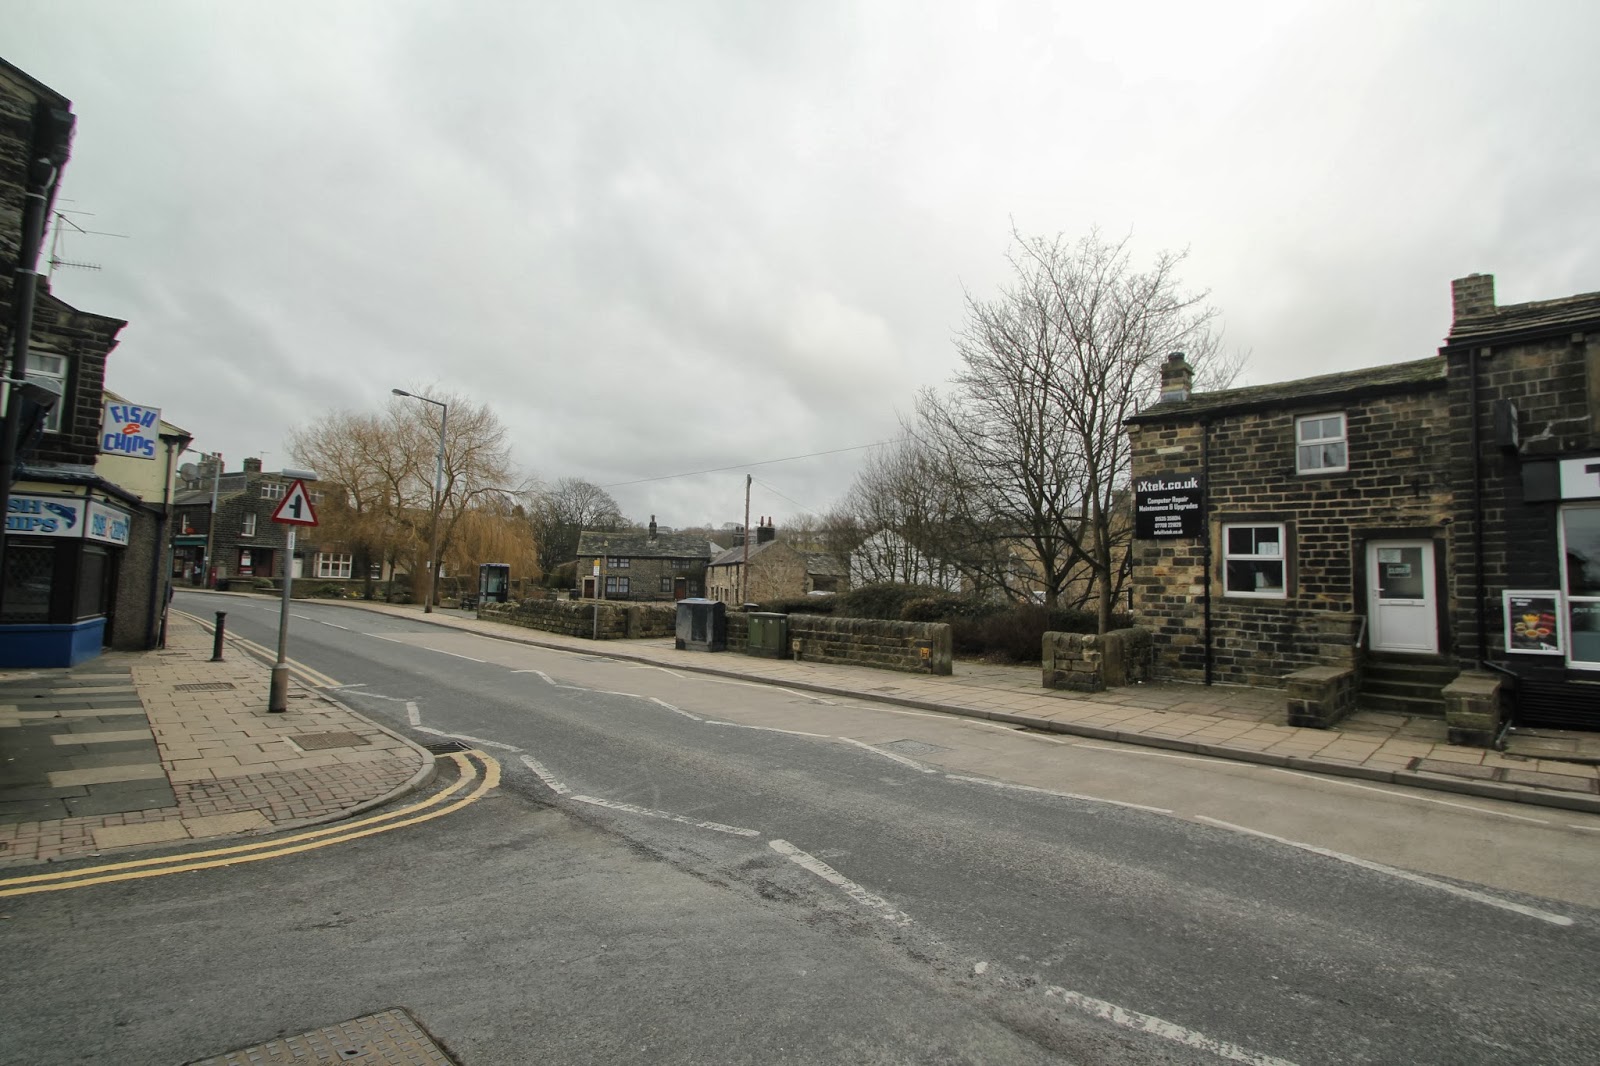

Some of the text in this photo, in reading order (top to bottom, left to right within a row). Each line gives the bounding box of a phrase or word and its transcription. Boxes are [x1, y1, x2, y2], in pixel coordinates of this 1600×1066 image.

[110, 405, 157, 428] FISH
[122, 423, 140, 434] &
[103, 433, 155, 456] CHIPS
[1174, 502, 1198, 511] Upgrades
